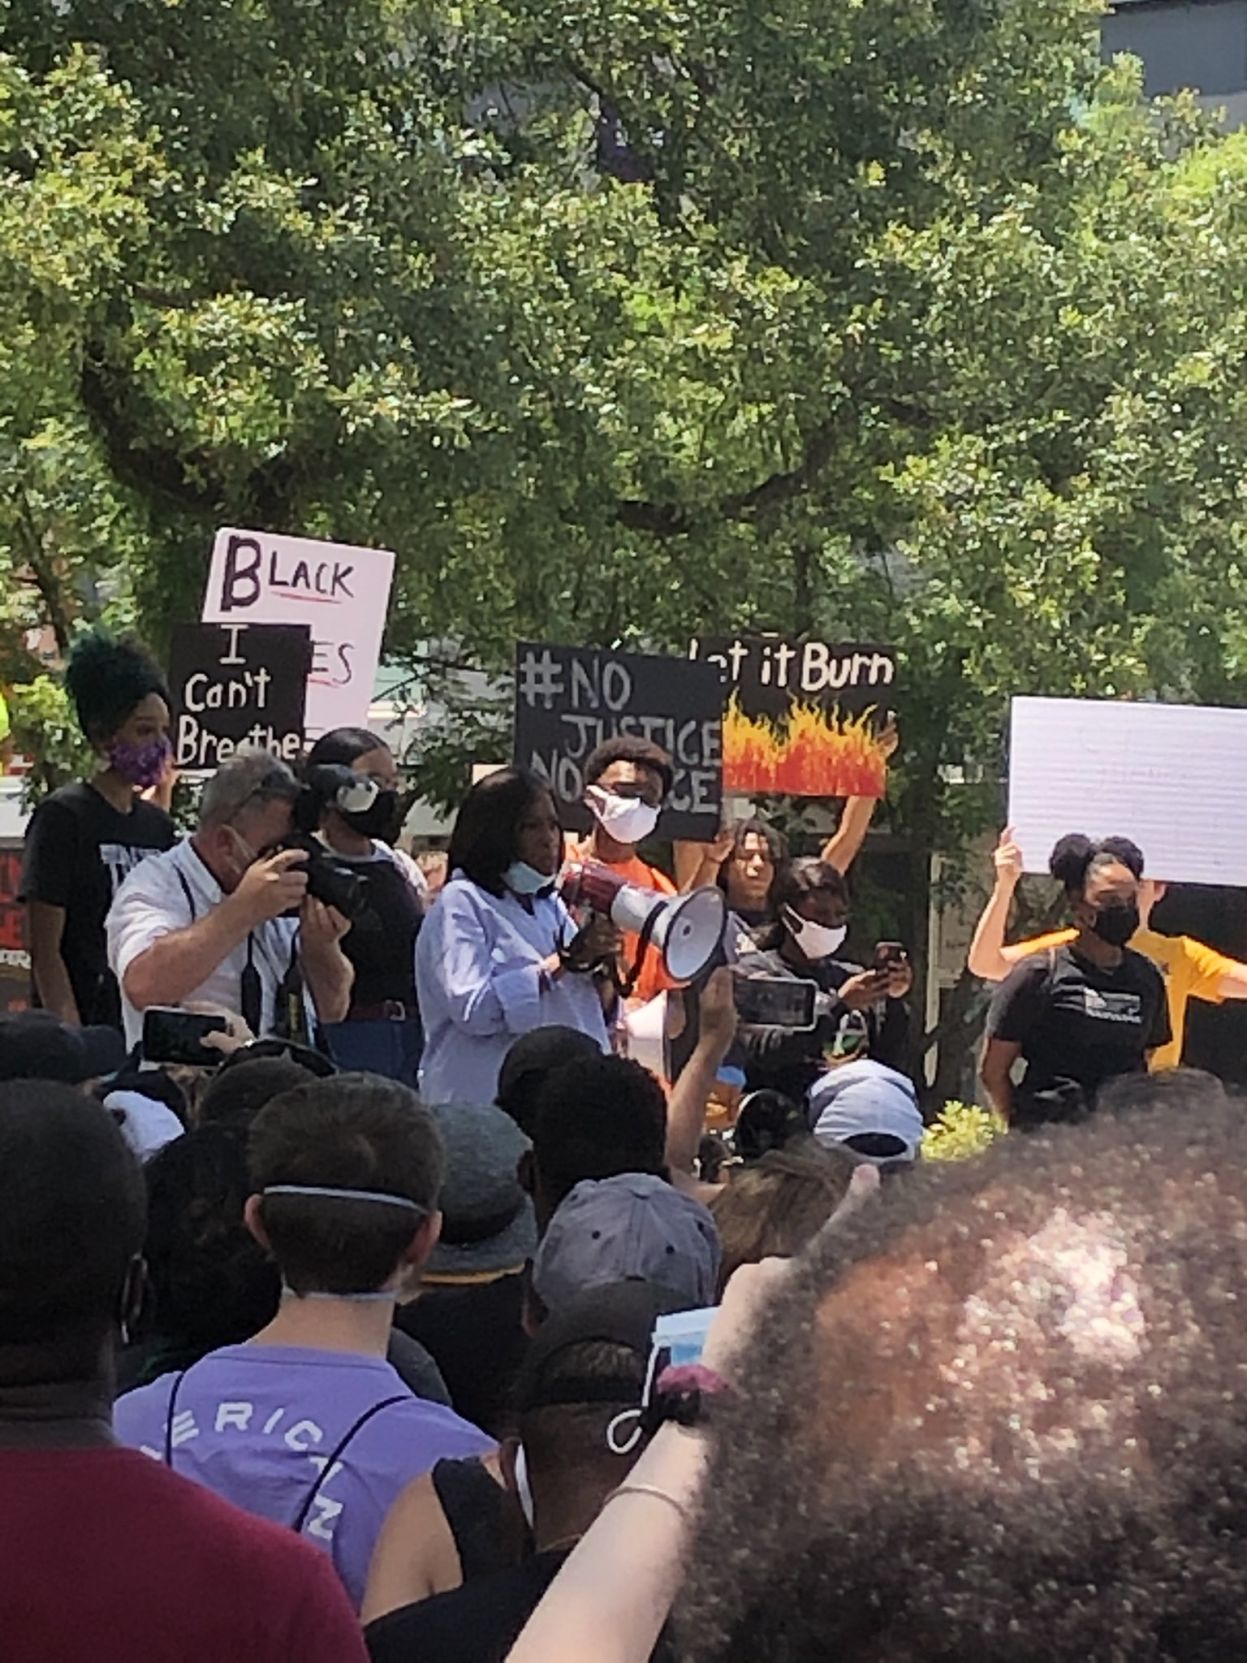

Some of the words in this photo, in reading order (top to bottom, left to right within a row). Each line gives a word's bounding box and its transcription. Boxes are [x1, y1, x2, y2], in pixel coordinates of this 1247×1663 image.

[220, 535, 354, 612] BLACK
[220, 624, 248, 664] I
[761, 643, 796, 687] it
[801, 642, 894, 691] Burn
[185, 667, 271, 712] Can't
[140, 1402, 344, 1541] ERICAN
